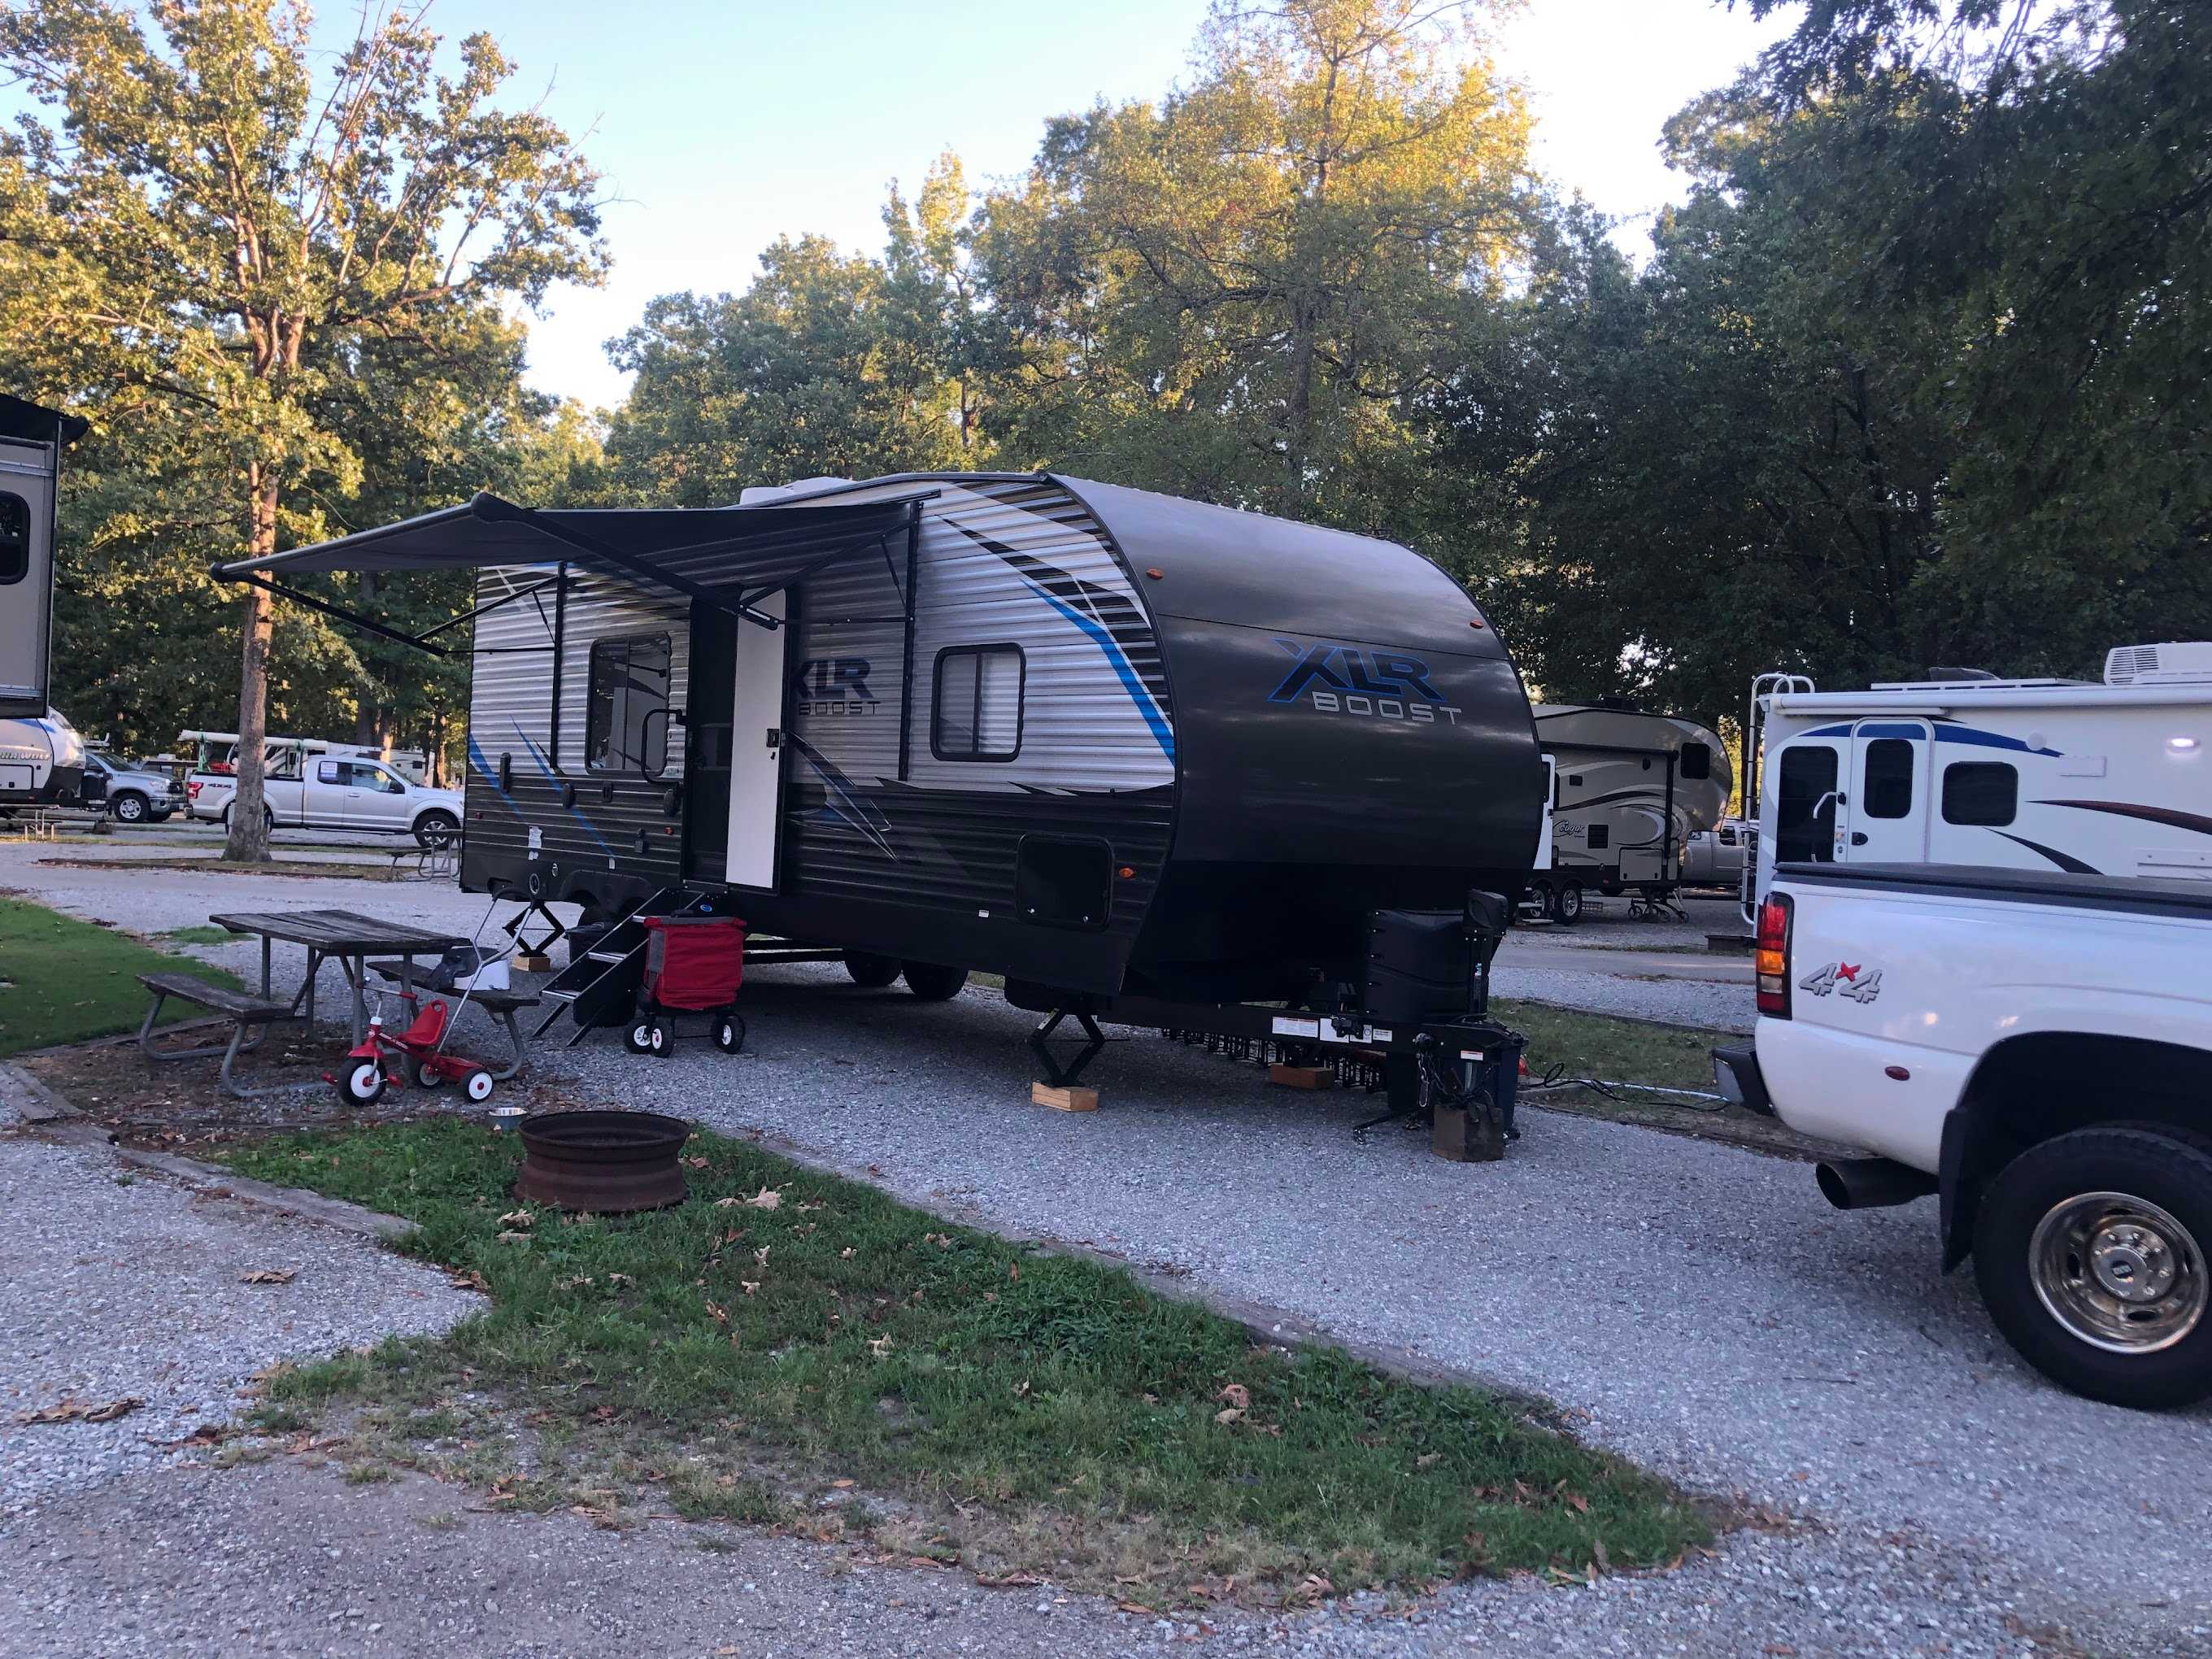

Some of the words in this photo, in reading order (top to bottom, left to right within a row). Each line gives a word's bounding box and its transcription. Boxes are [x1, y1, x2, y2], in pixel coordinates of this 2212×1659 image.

[1267, 638, 1446, 703] XLR
[799, 700, 881, 716] BOOST
[1312, 691, 1461, 725] BOOST
[1552, 819, 1585, 837] Cougar
